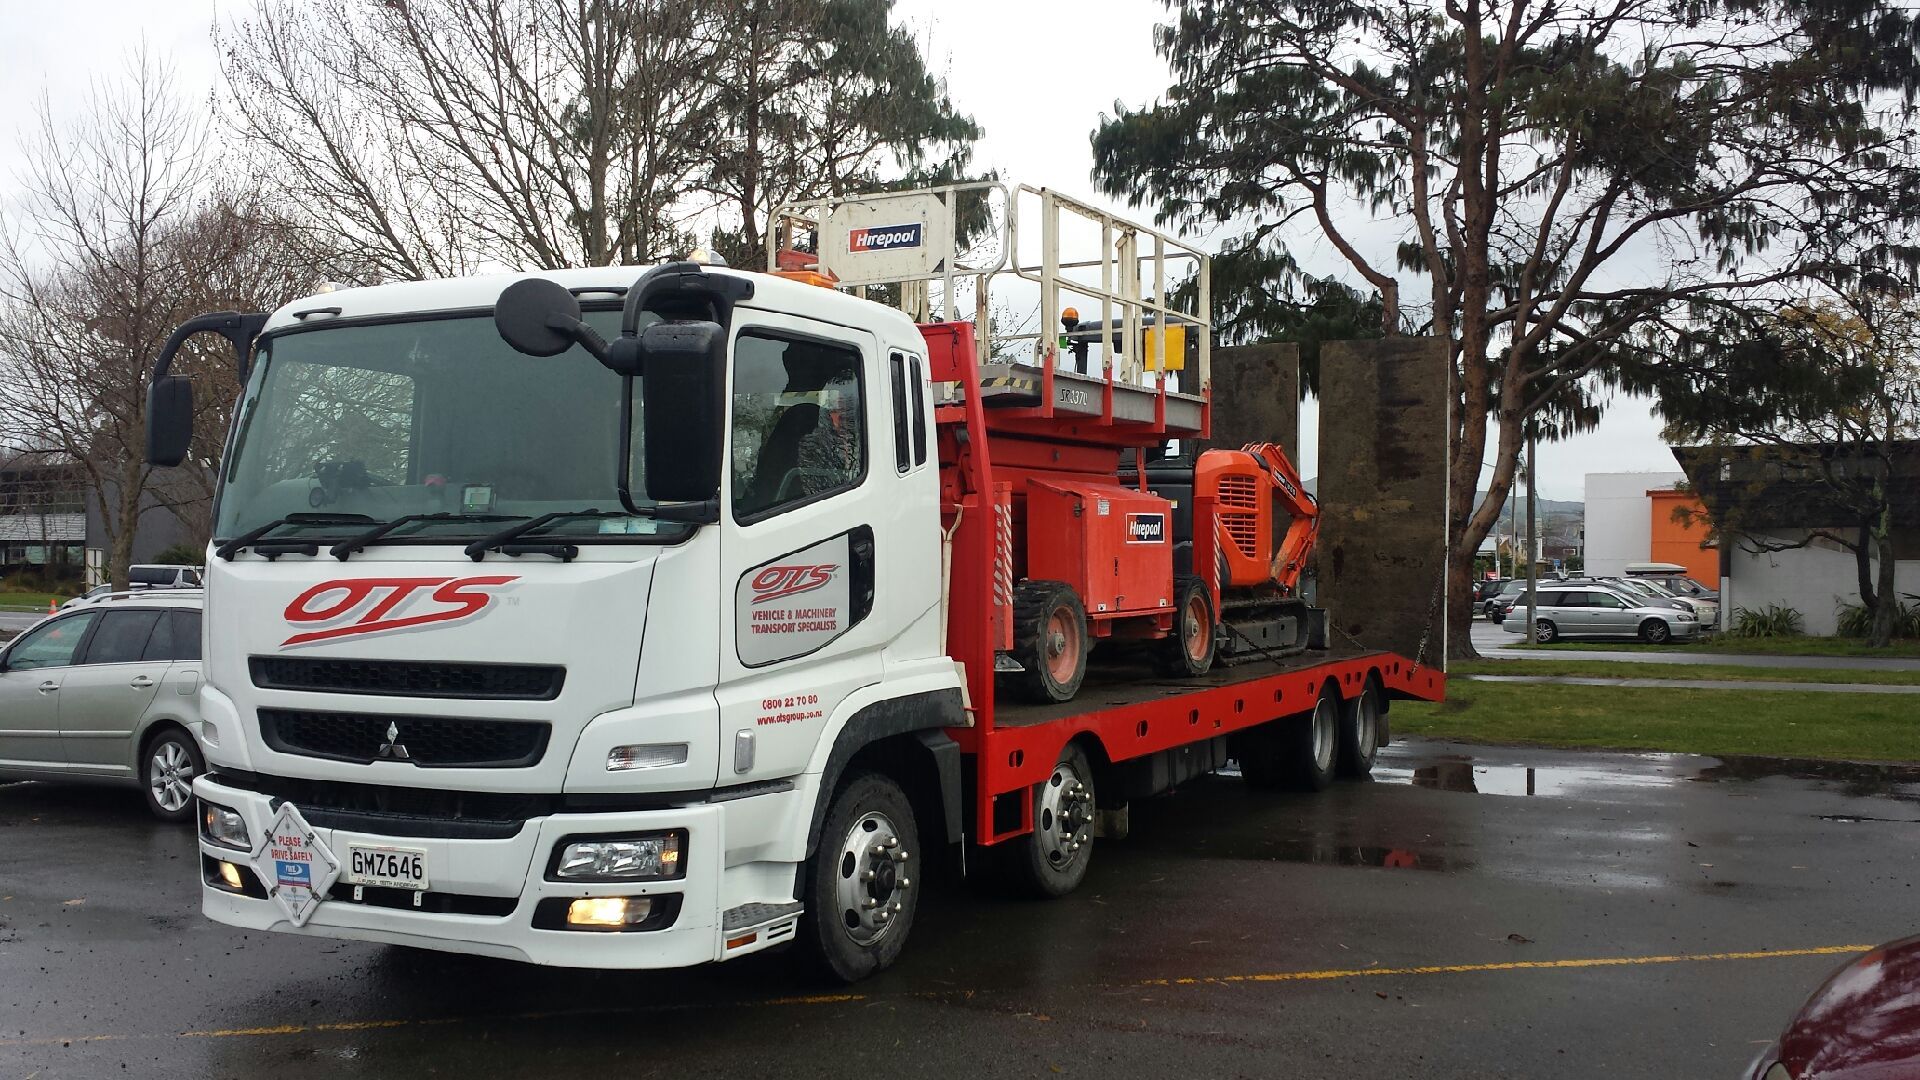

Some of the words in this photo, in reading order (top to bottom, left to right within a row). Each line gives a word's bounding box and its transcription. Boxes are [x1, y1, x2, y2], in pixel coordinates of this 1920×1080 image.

[856, 229, 916, 248] Hirepool
[1129, 520, 1161, 540] Hirepool
[751, 564, 839, 604] OTS
[280, 575, 522, 649] OTS
[752, 610, 785, 621] VEHICLE
[787, 609, 793, 620] &
[795, 607, 837, 619] MACHINERY
[751, 623, 796, 634] TRANSPORT
[797, 620, 837, 632] SPECIALISTS
[762, 699, 782, 710] 0800
[784, 697, 794, 708] 22
[796, 695, 806, 706] 70
[807, 694, 818, 704] 80
[757, 710, 822, 726] www.otsgroup.co.nz
[278, 835, 302, 847] PLEASE
[271, 849, 289, 860] DRIVE
[289, 851, 313, 861] SAFELY
[352, 851, 423, 880] GMZ646
